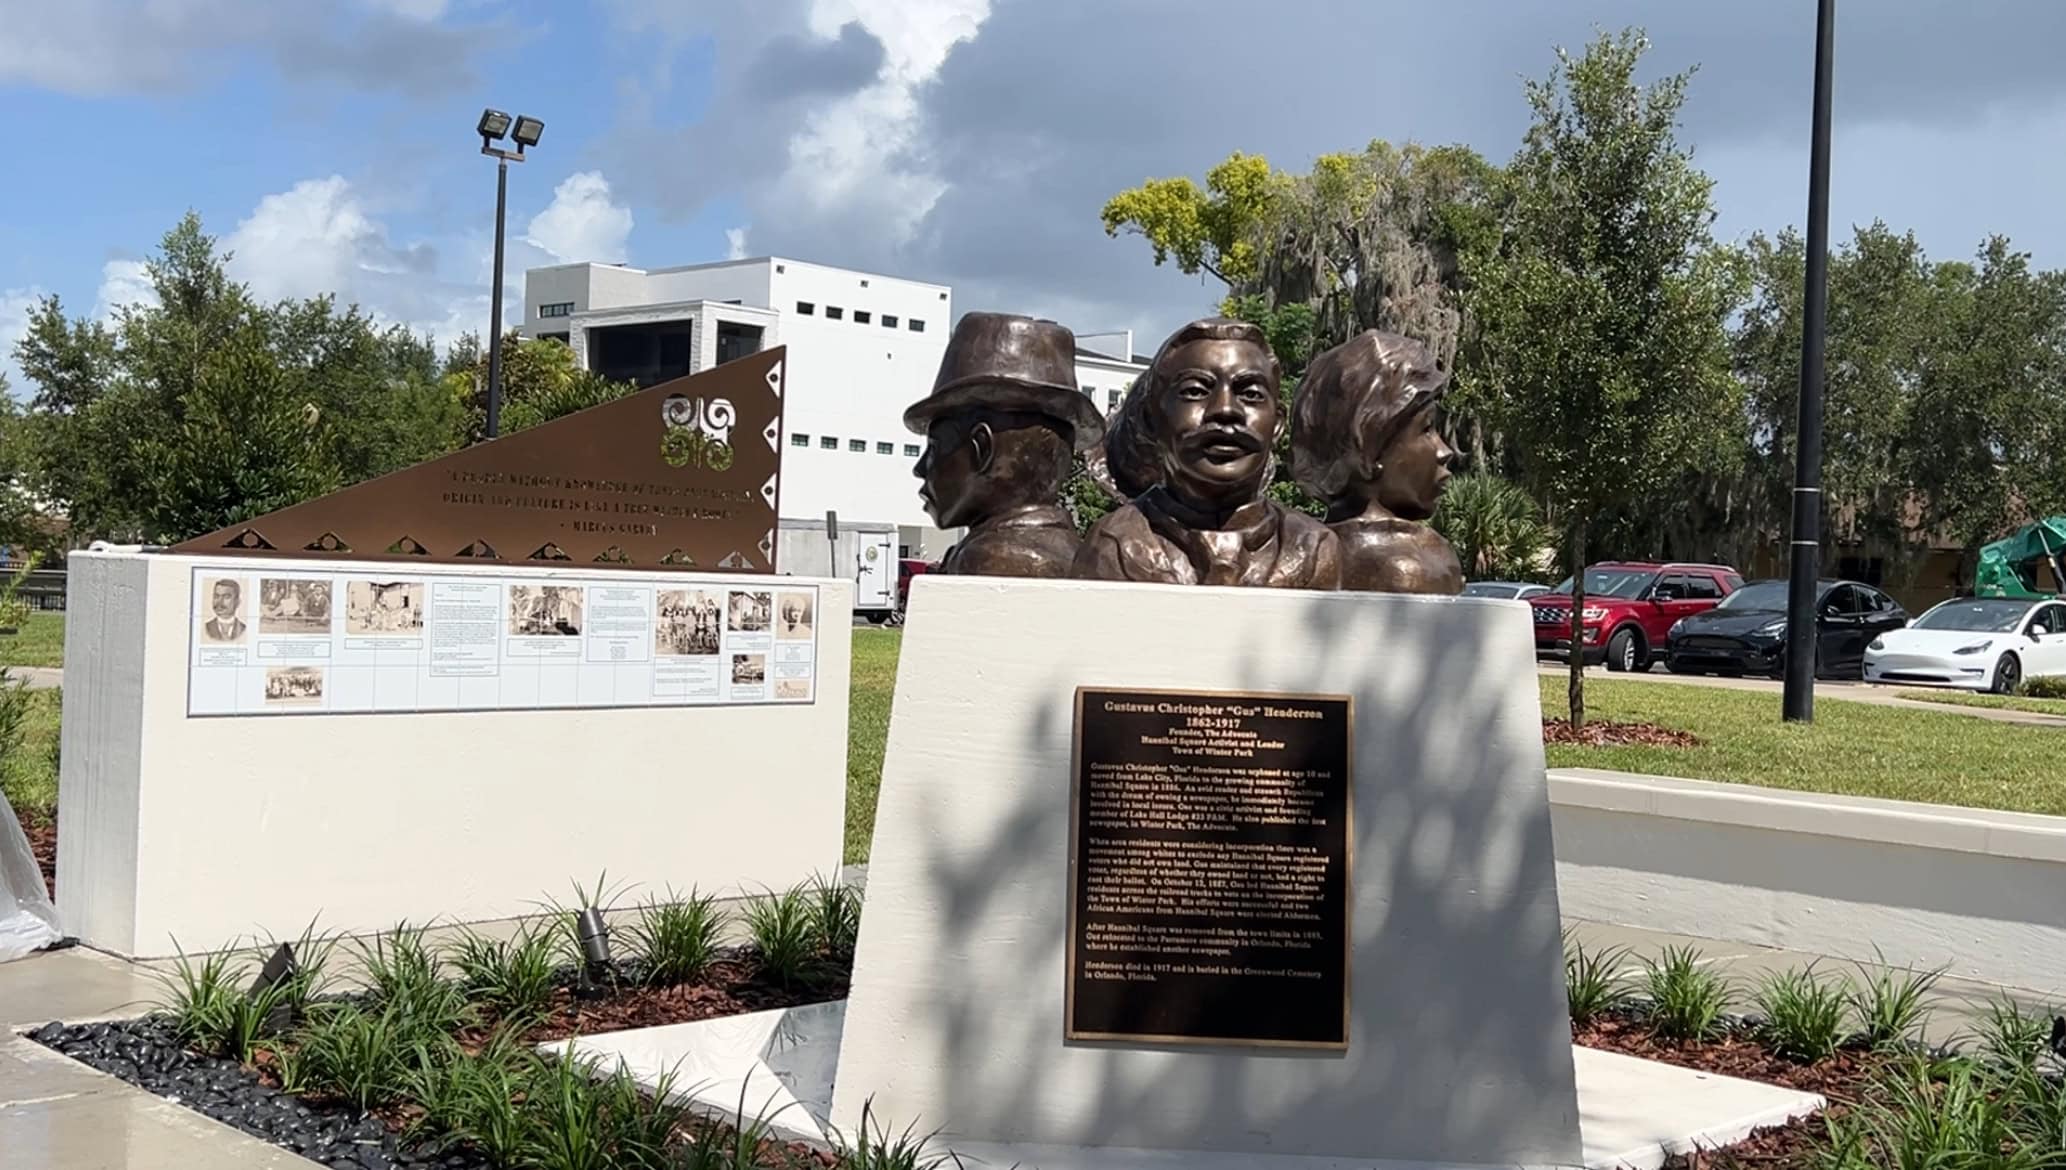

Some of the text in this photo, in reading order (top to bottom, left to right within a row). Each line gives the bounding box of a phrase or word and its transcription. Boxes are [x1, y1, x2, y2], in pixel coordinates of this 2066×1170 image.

[1104, 700, 1154, 713] Gustavus
[1157, 702, 1223, 717] Christopher
[1264, 705, 1324, 719] Henderson
[1186, 716, 1242, 729] 1862-1917
